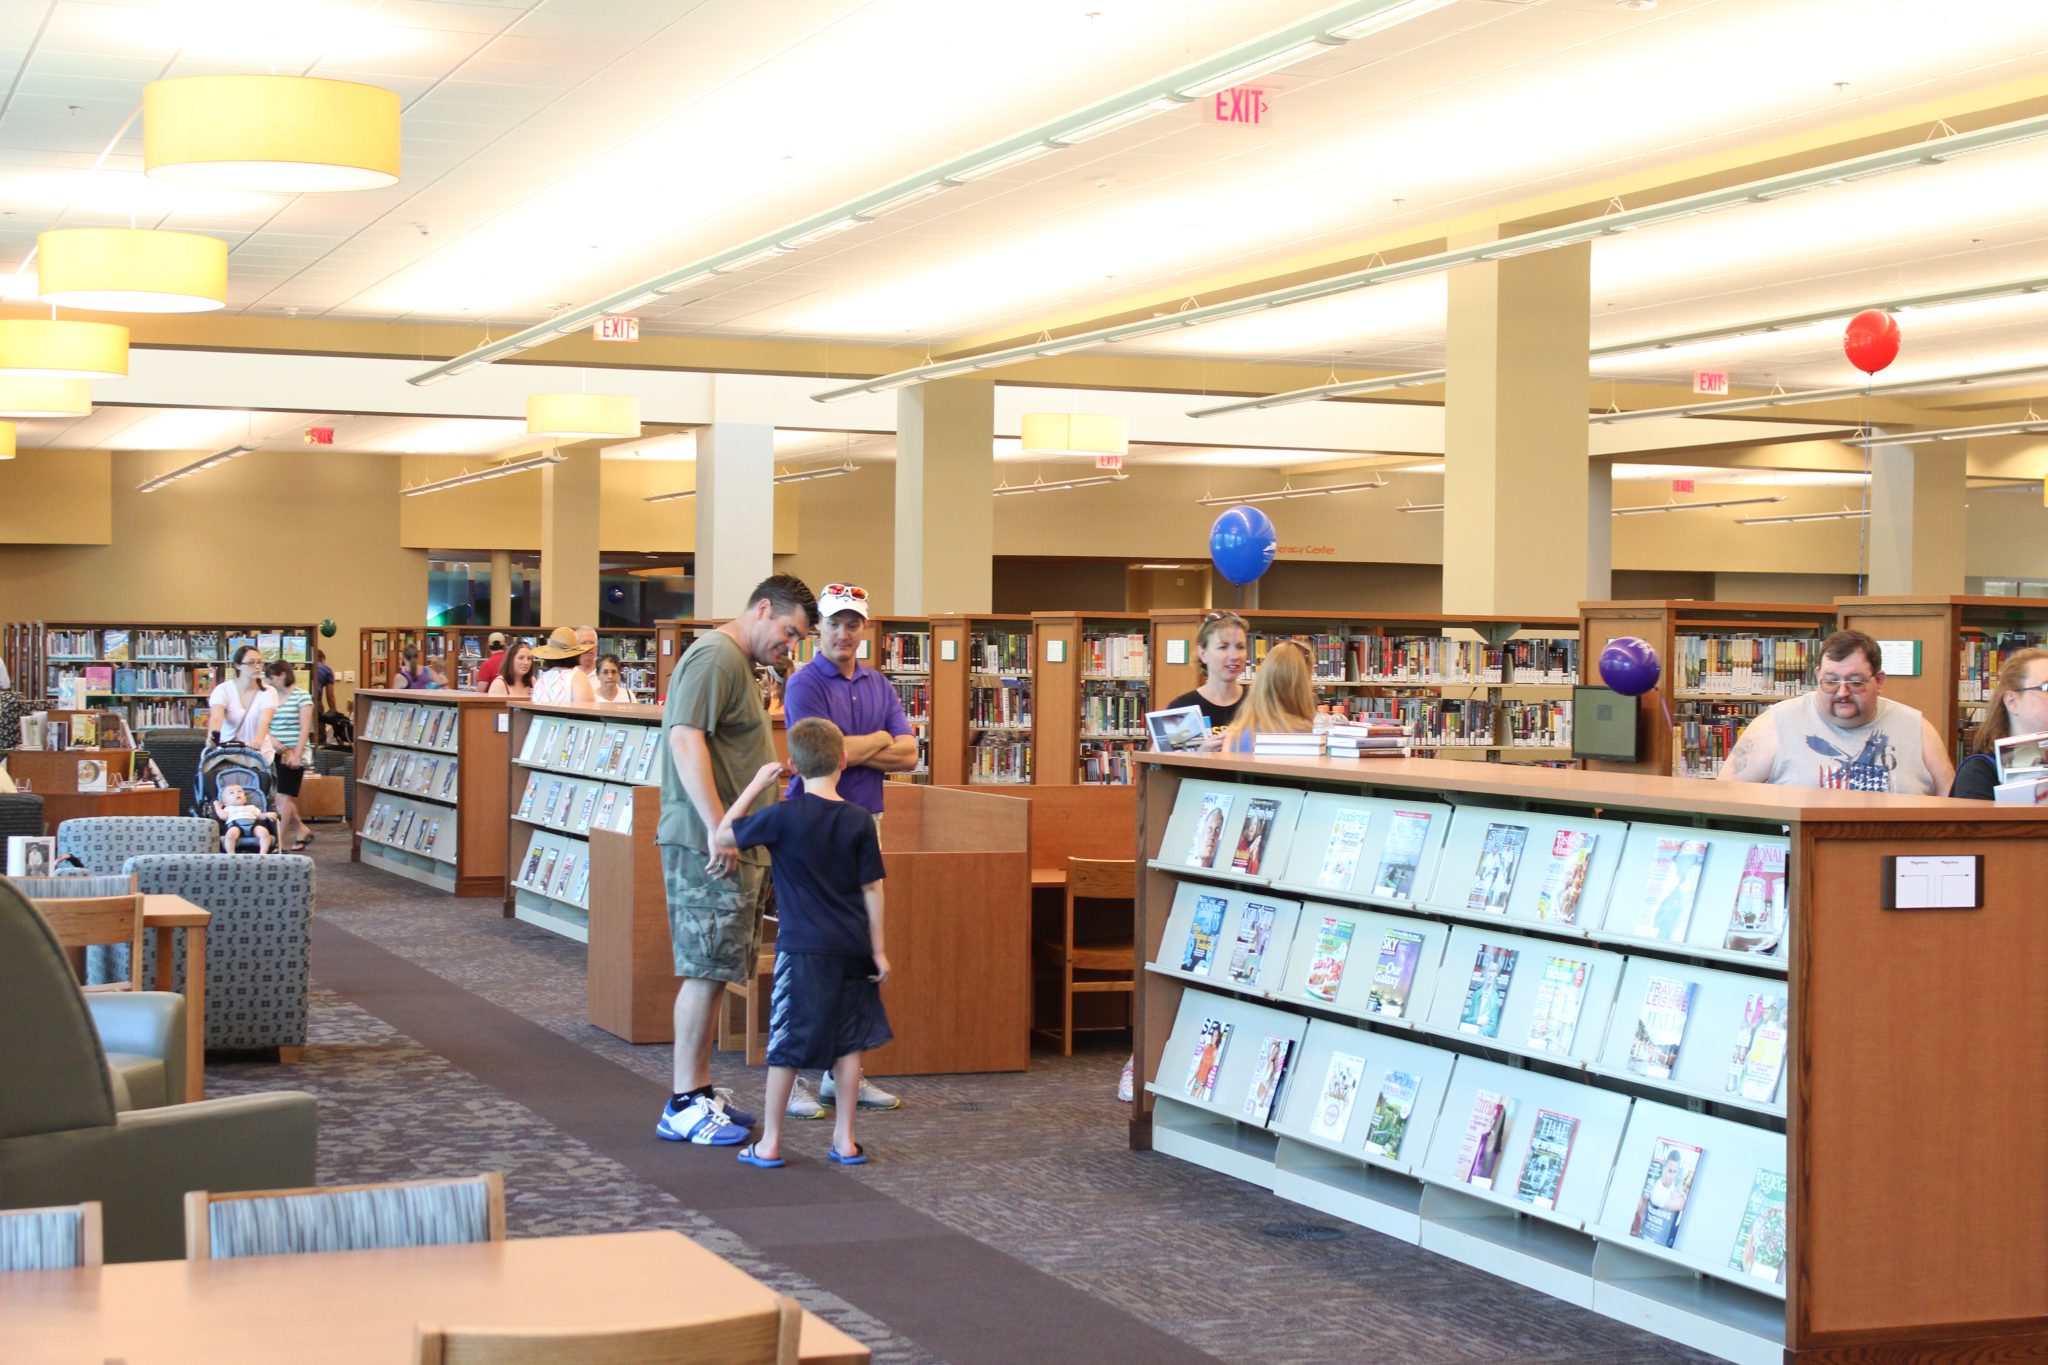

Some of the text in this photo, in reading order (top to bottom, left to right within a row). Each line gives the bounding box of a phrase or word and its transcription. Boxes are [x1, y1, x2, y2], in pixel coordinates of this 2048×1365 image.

[1216, 87, 1263, 124] EXIT
[603, 317, 633, 339] EXIT
[1700, 372, 1724, 392] EXIT
[1277, 545, 1335, 555] eracy Center
[1381, 936, 1399, 952] SKY
[1386, 961, 1403, 976] Our
[1476, 951, 1515, 971] TENIS
[1375, 970, 1401, 990] Galaxy
[1650, 981, 1686, 998] TRAVEL
[1646, 993, 1688, 1012] LEISURE
